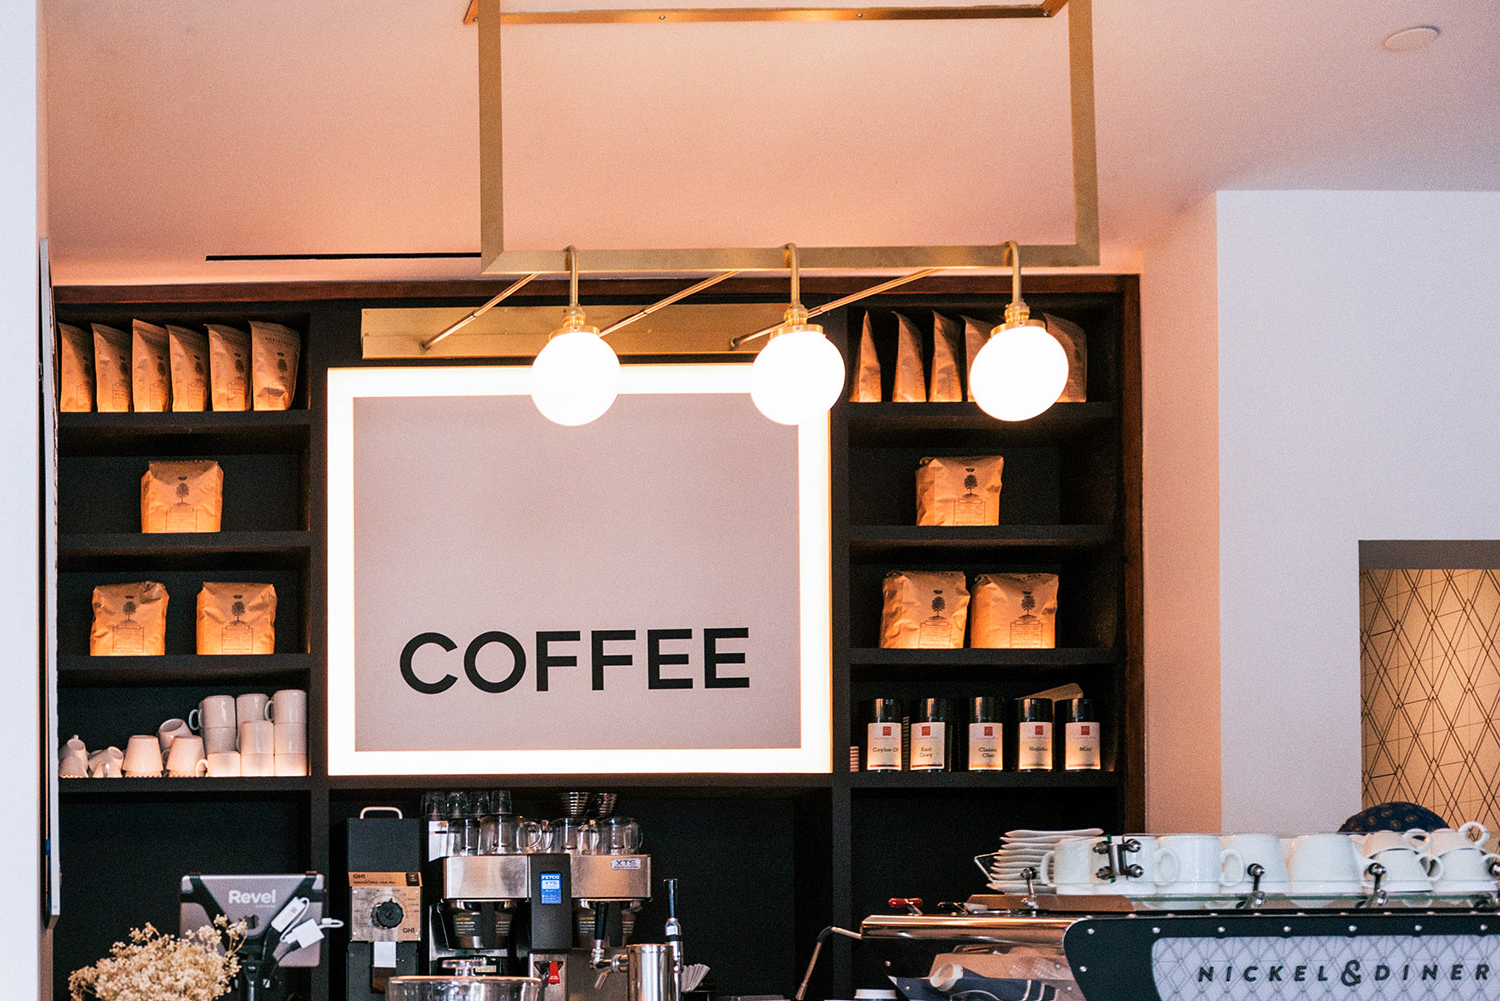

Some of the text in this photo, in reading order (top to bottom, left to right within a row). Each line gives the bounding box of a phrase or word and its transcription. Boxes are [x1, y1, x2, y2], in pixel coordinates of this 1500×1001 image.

[400, 627, 750, 694] COFFEE
[228, 889, 276, 904] Revel
[1197, 960, 1491, 987] NICKEL & DINER
